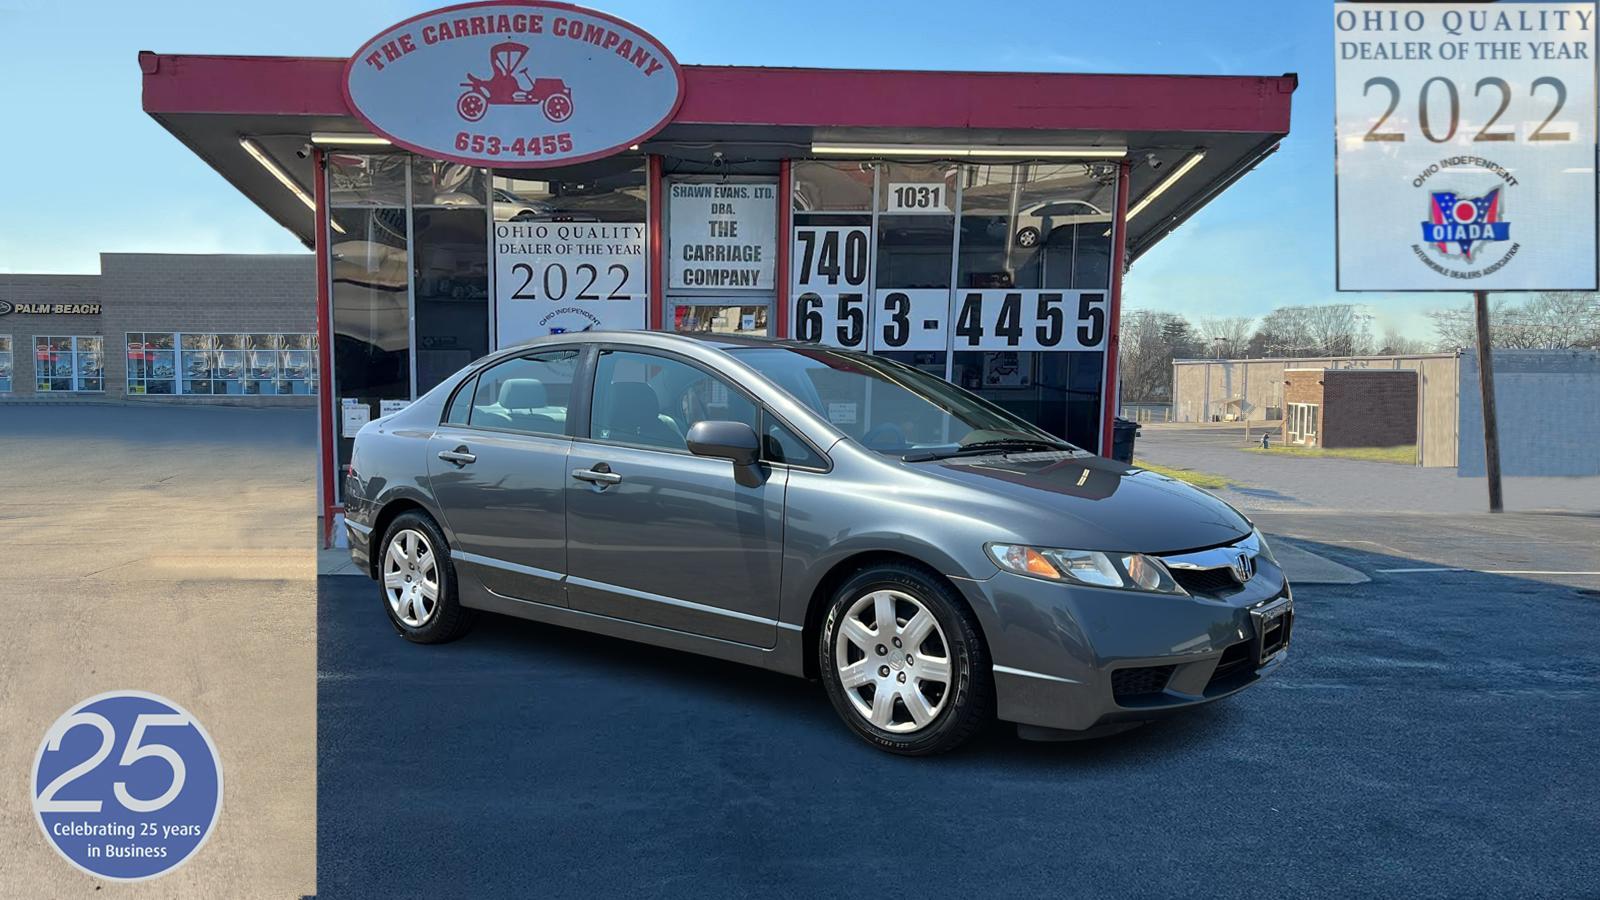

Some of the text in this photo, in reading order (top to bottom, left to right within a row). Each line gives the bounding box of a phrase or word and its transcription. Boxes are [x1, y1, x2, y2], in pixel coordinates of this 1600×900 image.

[1336, 10, 1593, 35] OHIO QUALITY
[366, 15, 664, 78] THE CARRIAGE COMPANY
[1341, 42, 1589, 60] DEALER OF THE YEAR
[1363, 76, 1571, 143] 2022
[455, 132, 573, 156] 653-4455
[1412, 155, 1519, 188] OHIO INDEPENDENT
[672, 186, 712, 200] SHAWN
[754, 187, 774, 200] LTD.
[894, 186, 940, 208] 1031
[711, 203, 736, 215] DBA.
[497, 226, 643, 241] OHIO QUALITY
[708, 220, 737, 238] THE
[1433, 225, 1495, 240] OIADA
[499, 243, 641, 256] DEALER OF THE YEAR
[683, 244, 762, 262] CARRIAGE
[798, 230, 867, 286] 740
[511, 263, 631, 300] 2022
[683, 268, 760, 286] COMPANY
[14, 303, 100, 314] PALM BEACH
